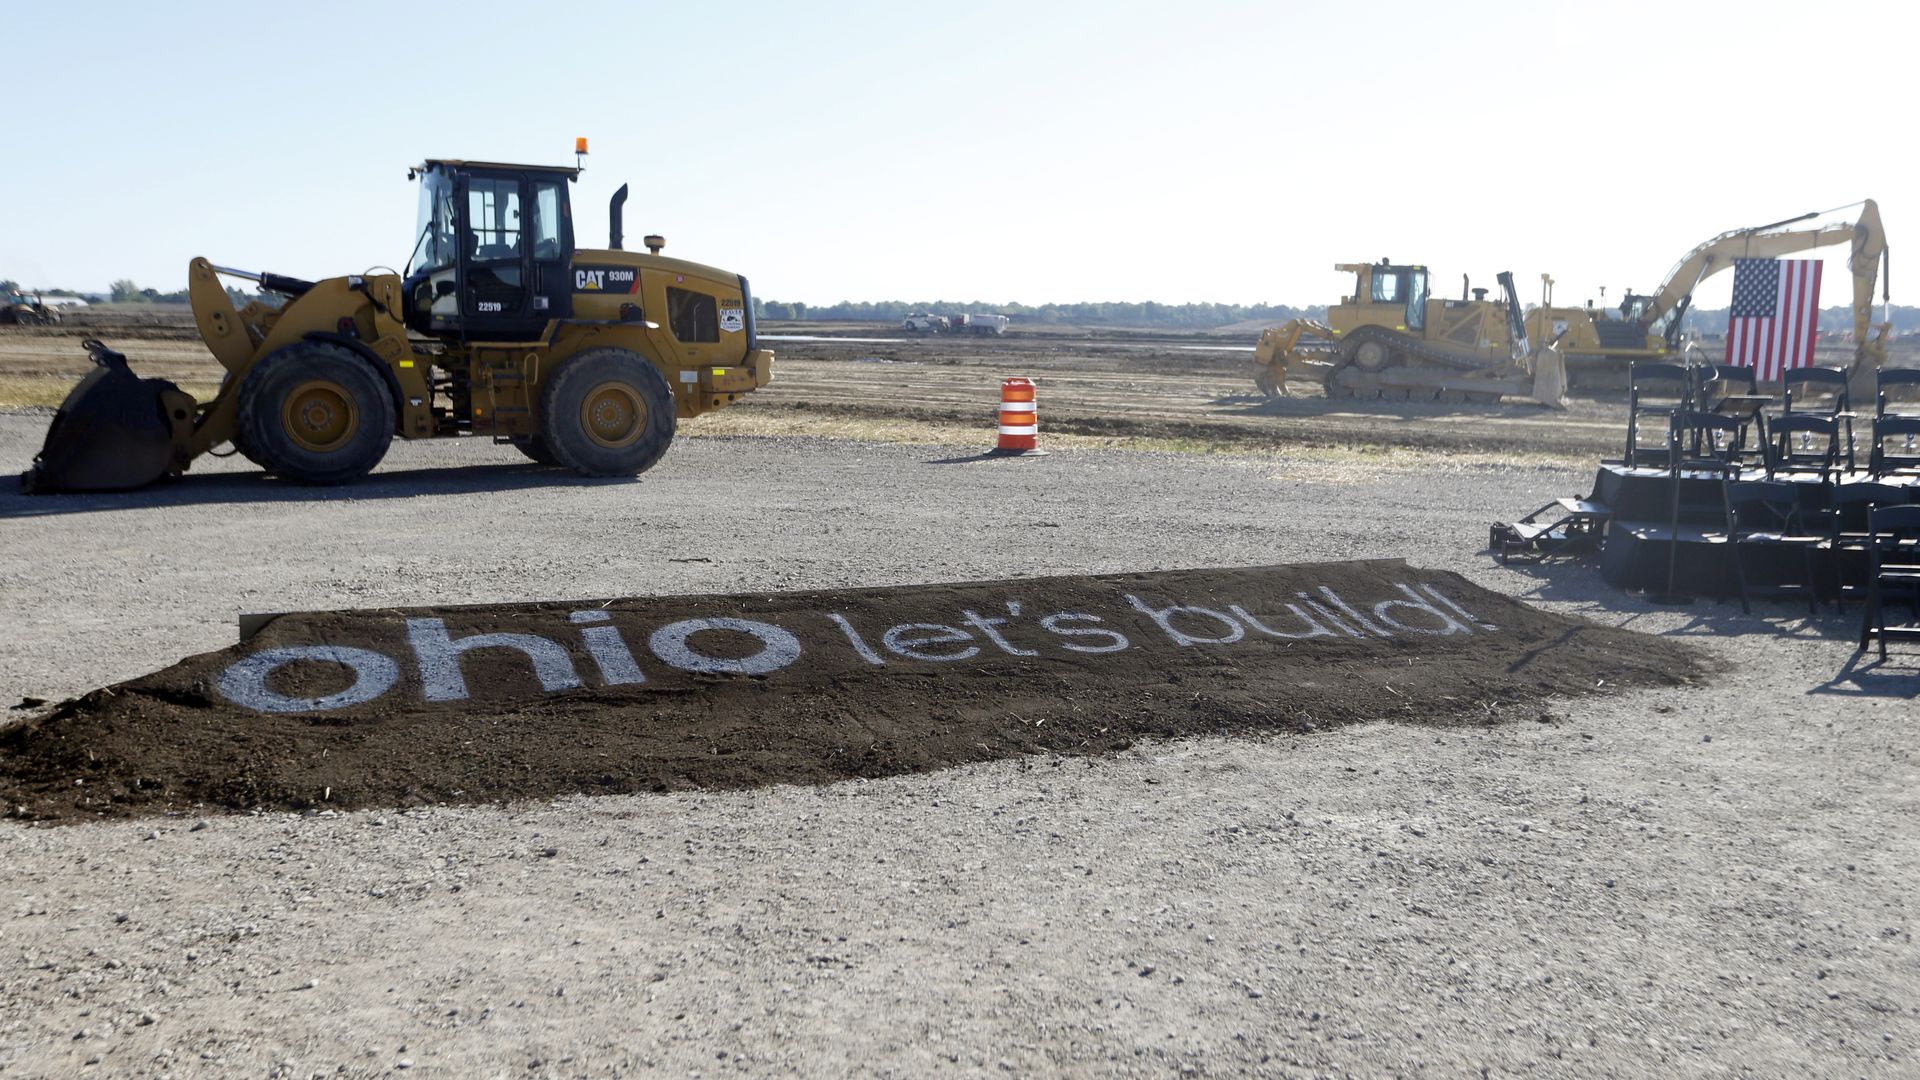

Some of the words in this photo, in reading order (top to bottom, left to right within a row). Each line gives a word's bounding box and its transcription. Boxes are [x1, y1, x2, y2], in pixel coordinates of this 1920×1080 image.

[576, 270, 604, 290] CAT
[608, 271, 633, 281] 930M
[478, 301, 501, 311] 22519
[216, 610, 801, 713] ohio
[828, 601, 1129, 665] let's
[1123, 583, 1499, 646] build!
